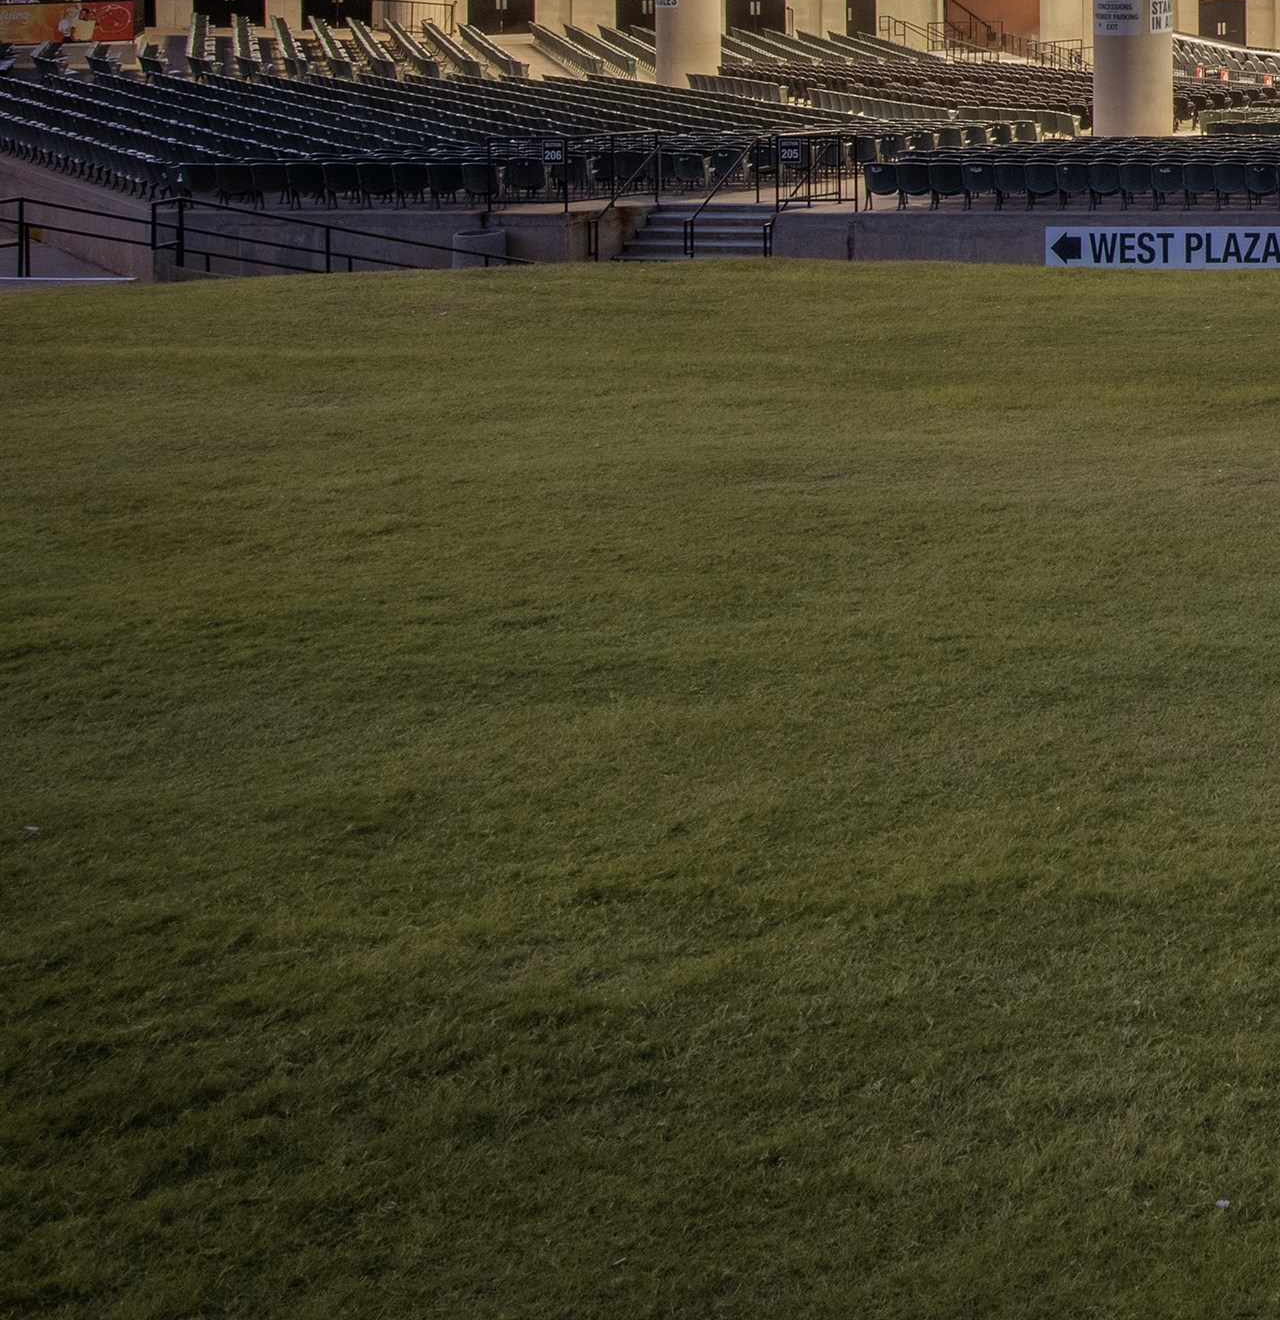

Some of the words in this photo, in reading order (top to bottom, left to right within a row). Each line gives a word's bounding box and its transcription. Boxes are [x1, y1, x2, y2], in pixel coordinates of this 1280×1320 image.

[1106, 23, 1118, 31] EXIT
[1152, 16, 1162, 31] IN
[544, 150, 562, 160] 206
[781, 148, 799, 159] 205
[1089, 232, 1174, 264] WEST
